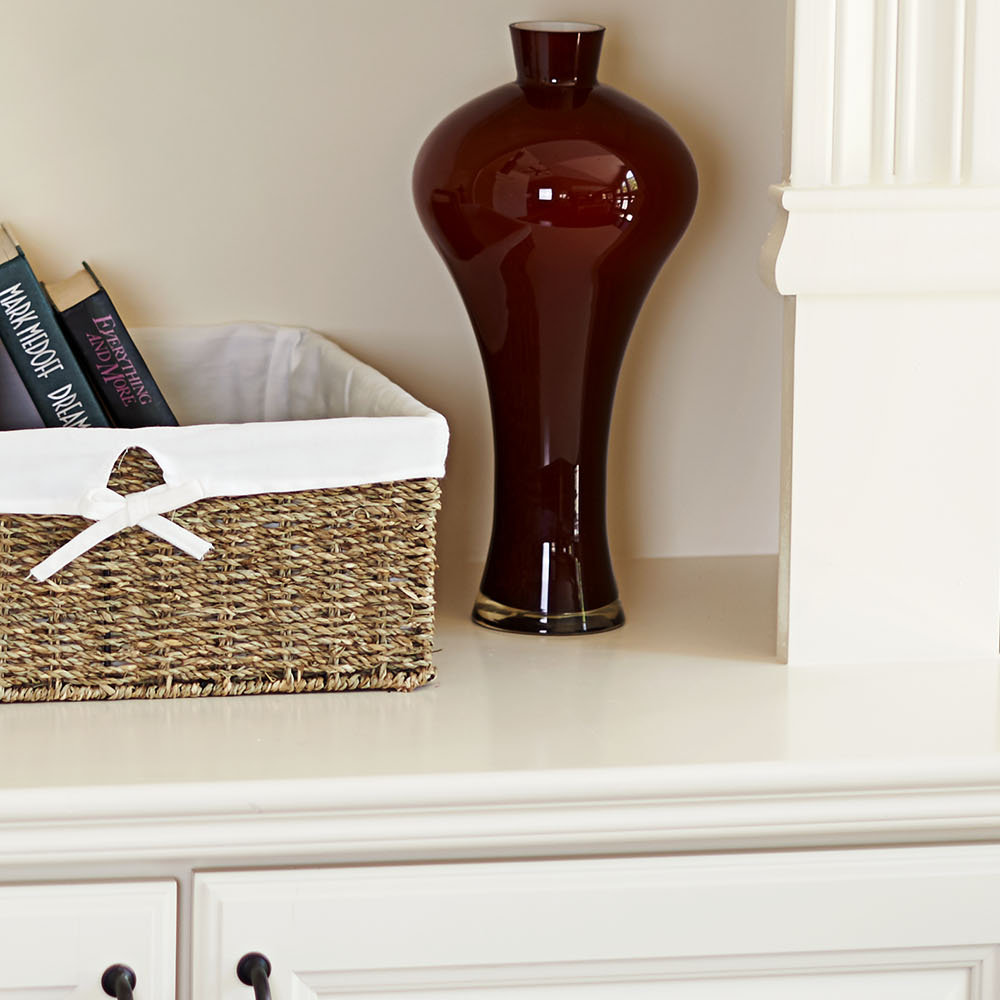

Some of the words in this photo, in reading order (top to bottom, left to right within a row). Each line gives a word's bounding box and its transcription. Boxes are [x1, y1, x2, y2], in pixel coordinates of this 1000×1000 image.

[16, 322, 65, 378] MEDOFF
[86, 333, 112, 362] AND
[92, 314, 152, 405] EVERYTHING
[96, 363, 137, 407] MORE
